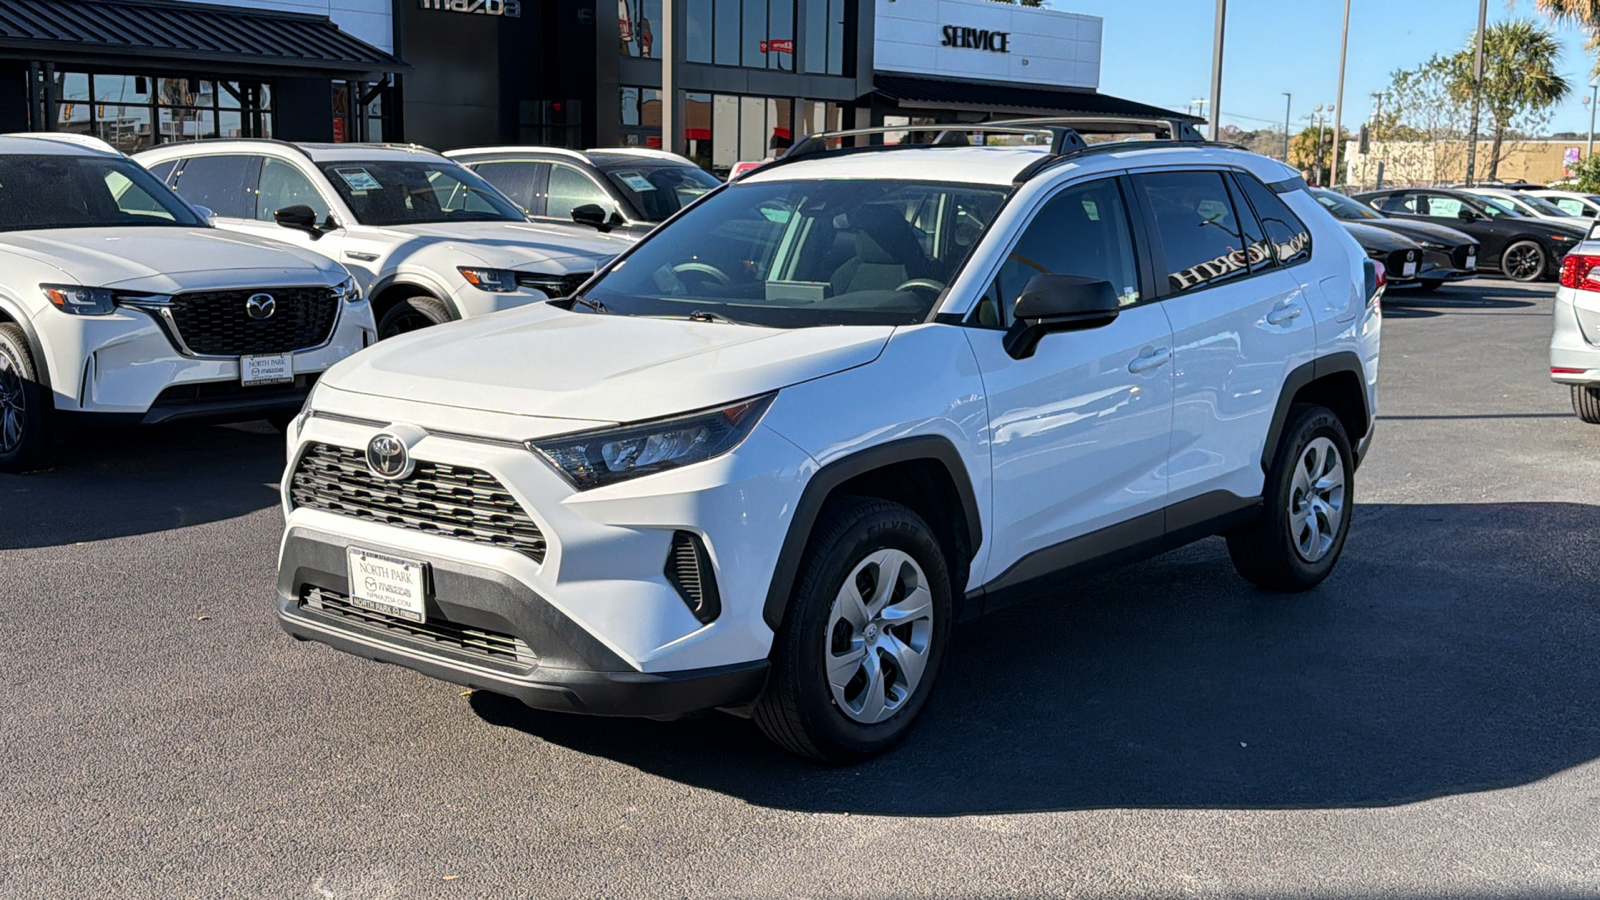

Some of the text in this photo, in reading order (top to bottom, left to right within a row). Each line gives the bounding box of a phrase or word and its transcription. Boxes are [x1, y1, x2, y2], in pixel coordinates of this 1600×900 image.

[941, 24, 1011, 53] SERVICE
[867, 520, 918, 535] SILVER
[359, 561, 412, 584] NORTH PARK
[378, 581, 412, 598] mazda
[353, 597, 375, 609] NORTH
[375, 602, 392, 614] PARK
